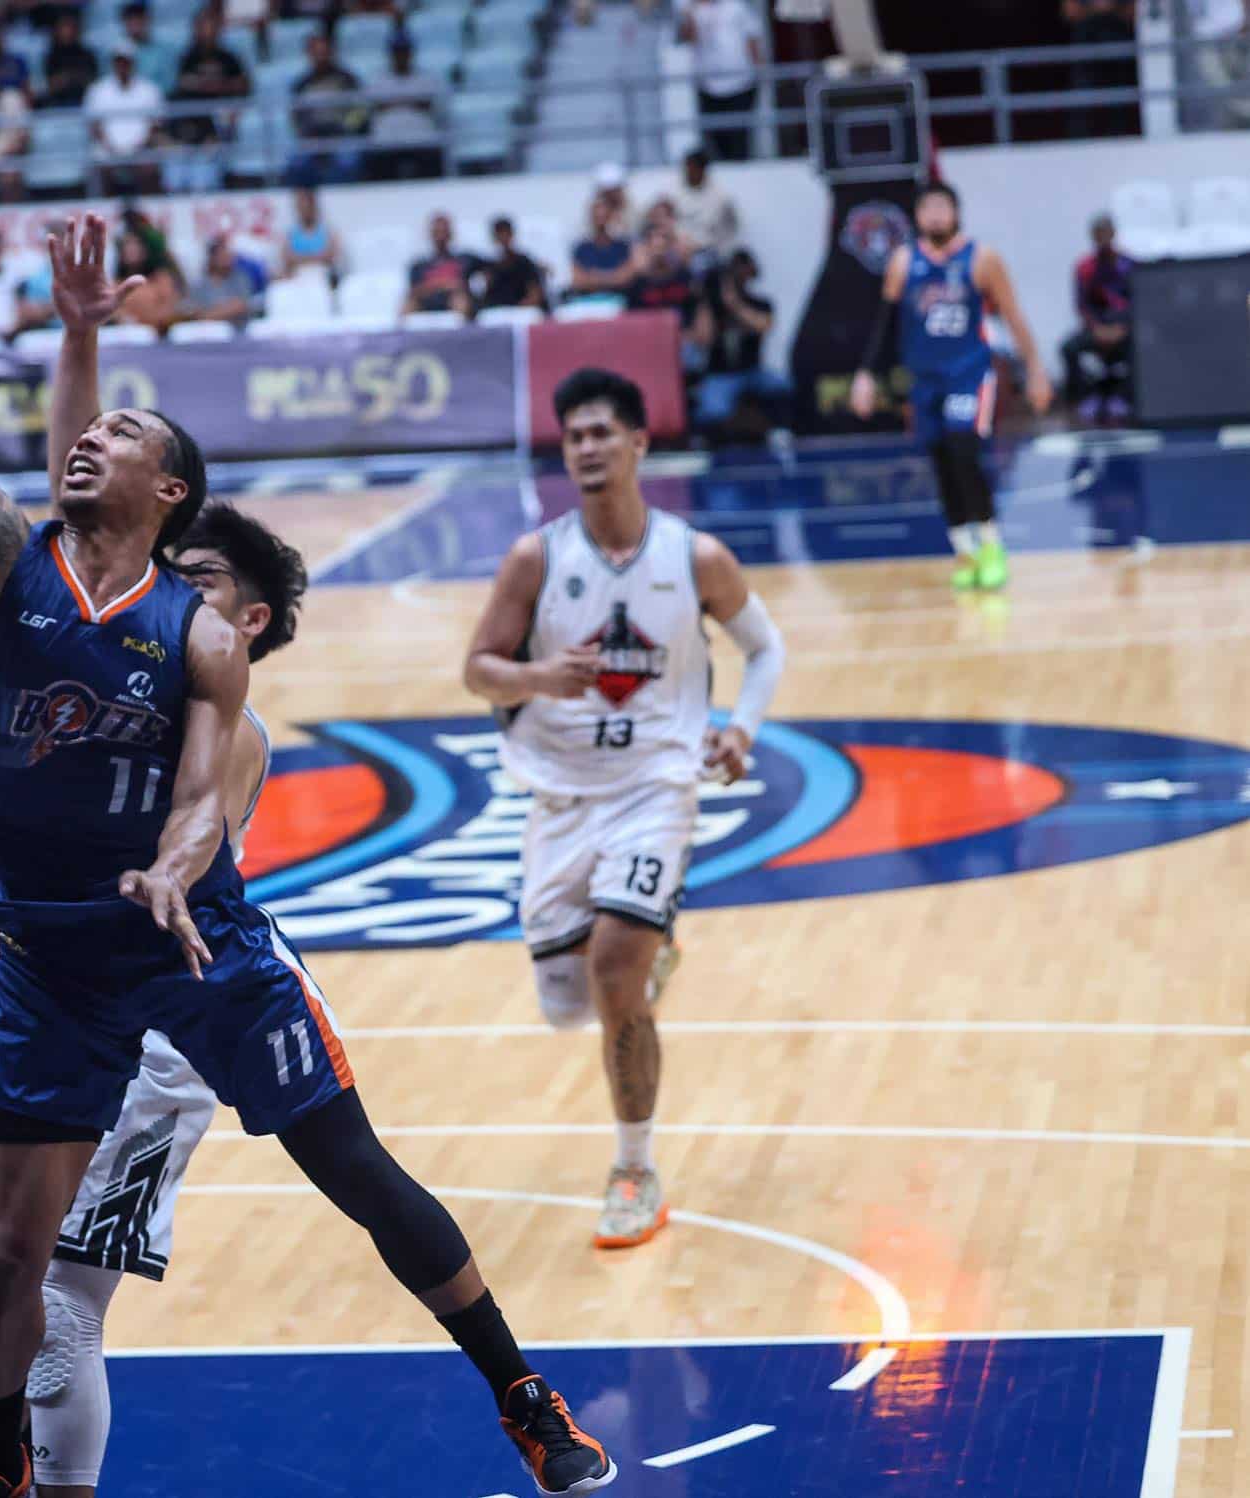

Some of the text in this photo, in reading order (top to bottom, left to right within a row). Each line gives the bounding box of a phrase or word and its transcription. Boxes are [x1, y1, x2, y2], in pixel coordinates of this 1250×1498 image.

[596, 717, 634, 749] 13
[108, 756, 162, 815] 11
[626, 855, 663, 896] 13
[267, 1019, 313, 1087] 11
